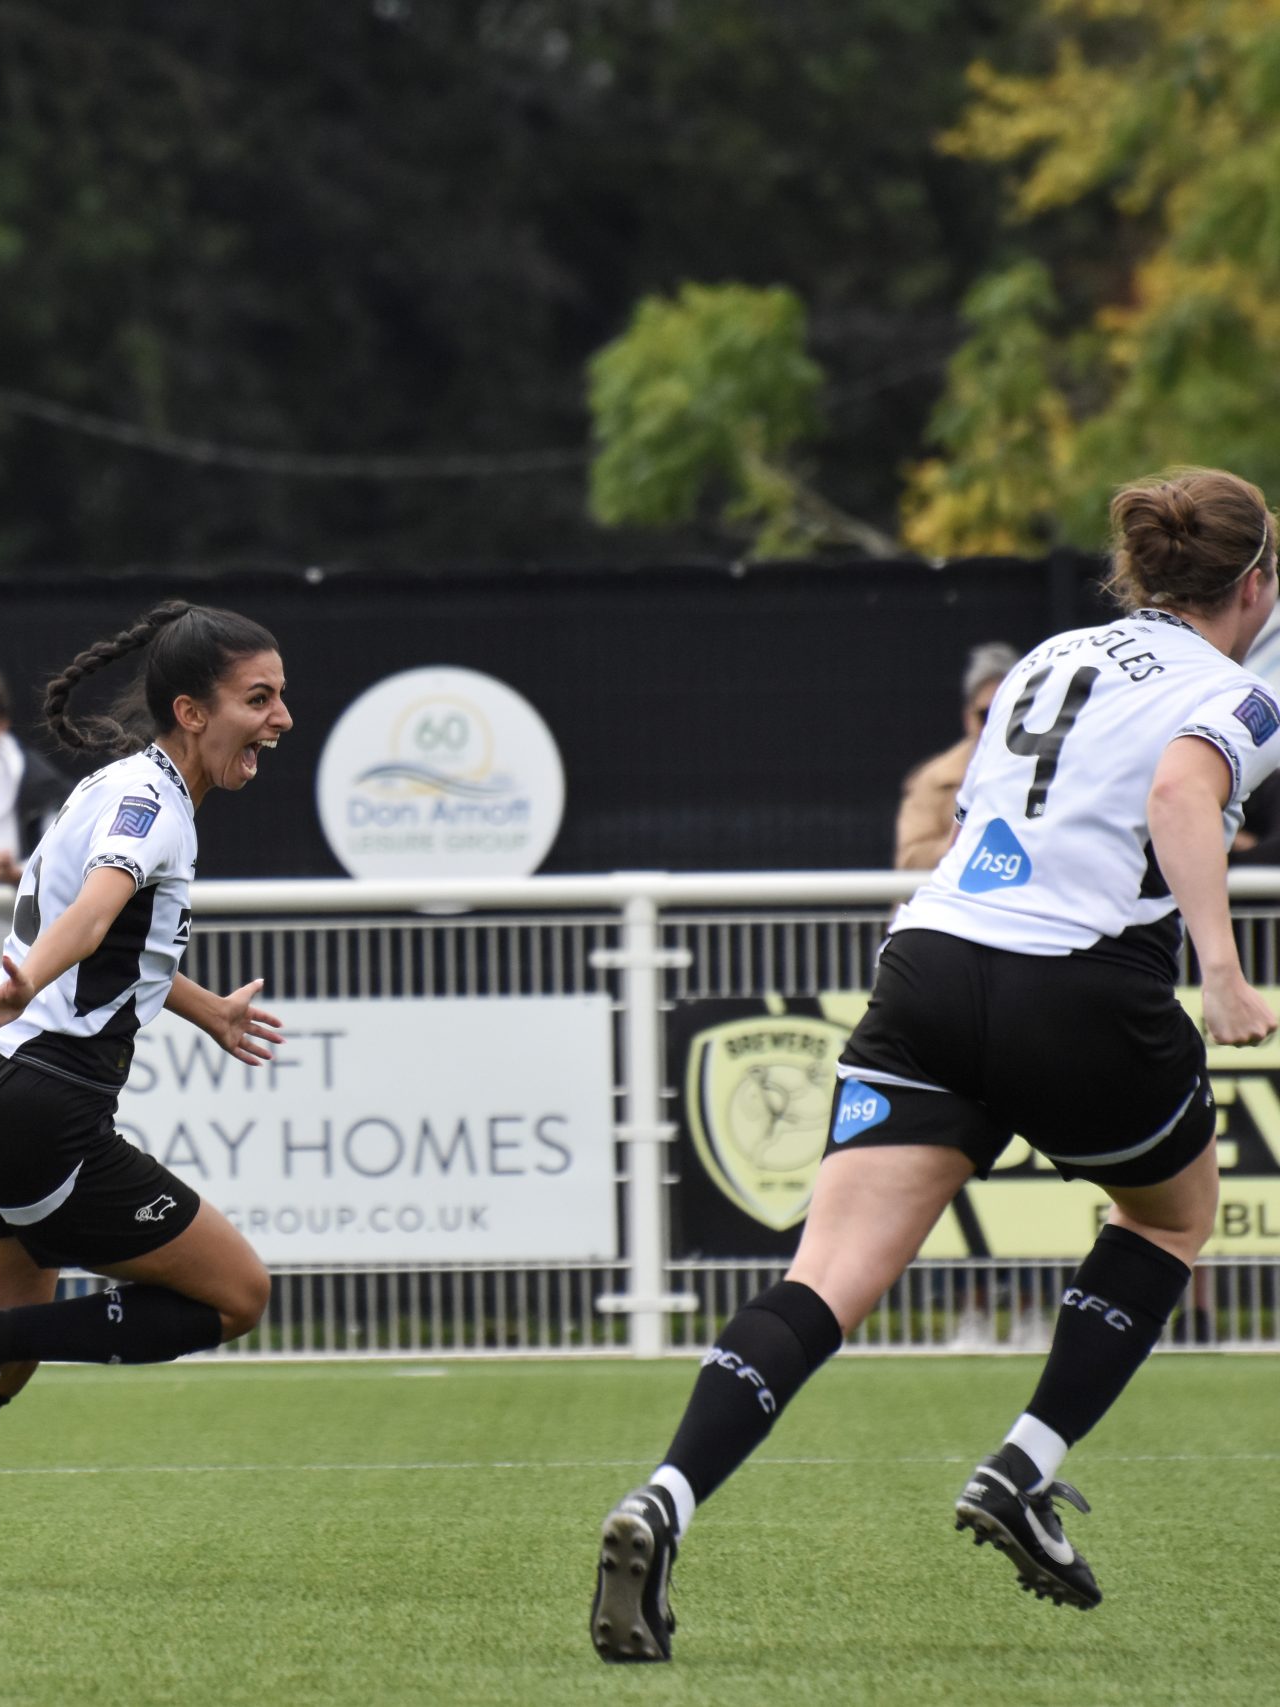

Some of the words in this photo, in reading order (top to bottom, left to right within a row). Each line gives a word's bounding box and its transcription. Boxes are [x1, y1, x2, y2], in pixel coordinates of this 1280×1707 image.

[414, 715, 470, 751] 60
[1005, 665, 1102, 820] 4
[347, 799, 418, 828] Don
[971, 846, 1023, 881] hsg
[839, 1097, 878, 1124] hsg
[281, 1114, 573, 1181] HOMES
